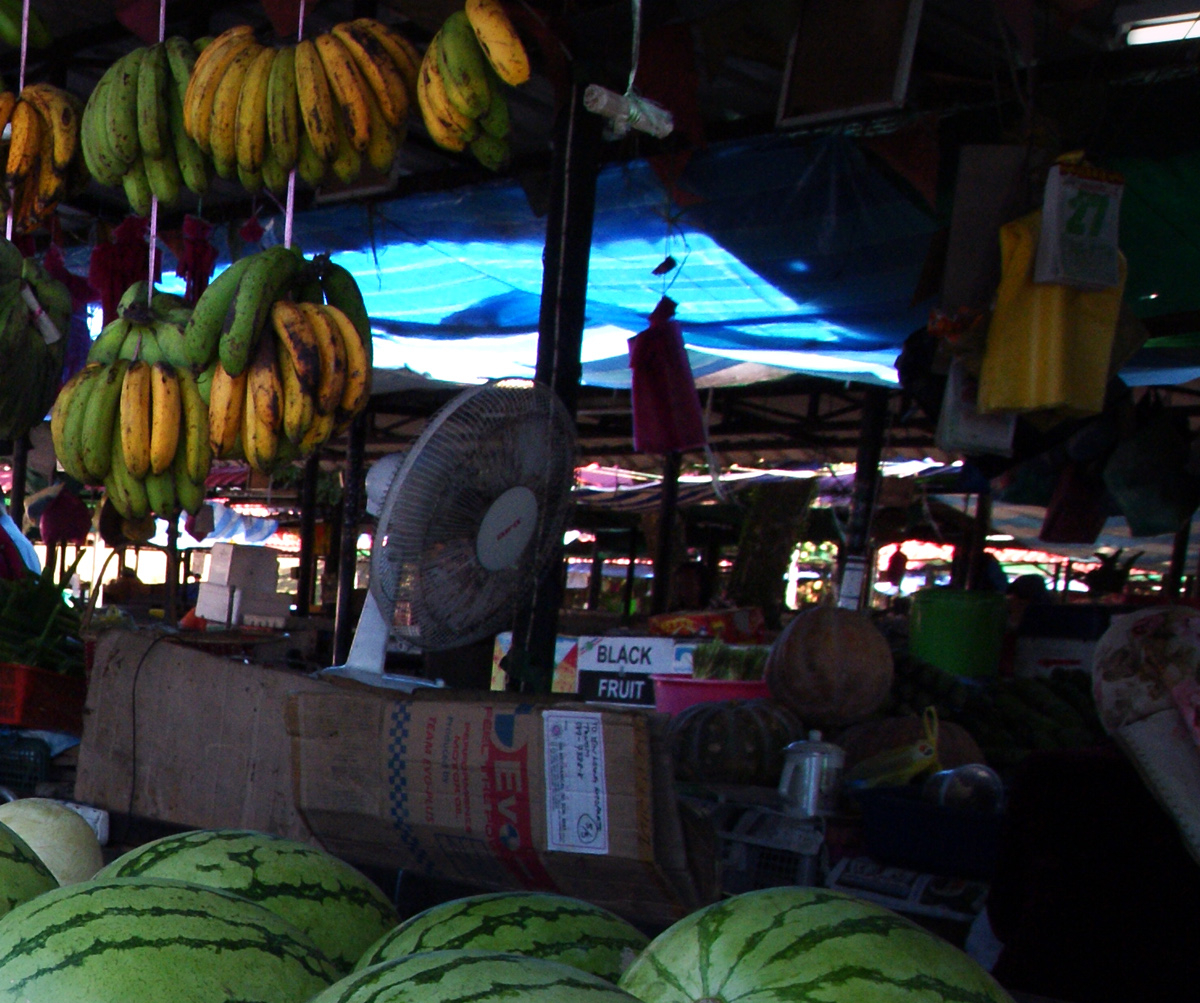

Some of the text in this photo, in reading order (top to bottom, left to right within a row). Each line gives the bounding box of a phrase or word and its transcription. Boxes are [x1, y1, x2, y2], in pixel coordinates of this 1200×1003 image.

[1065, 189, 1110, 236] 27
[597, 644, 652, 665] BLACK
[598, 679, 646, 699] FRUIT
[424, 716, 437, 754] TEAM
[452, 735, 461, 793] MOTOR
